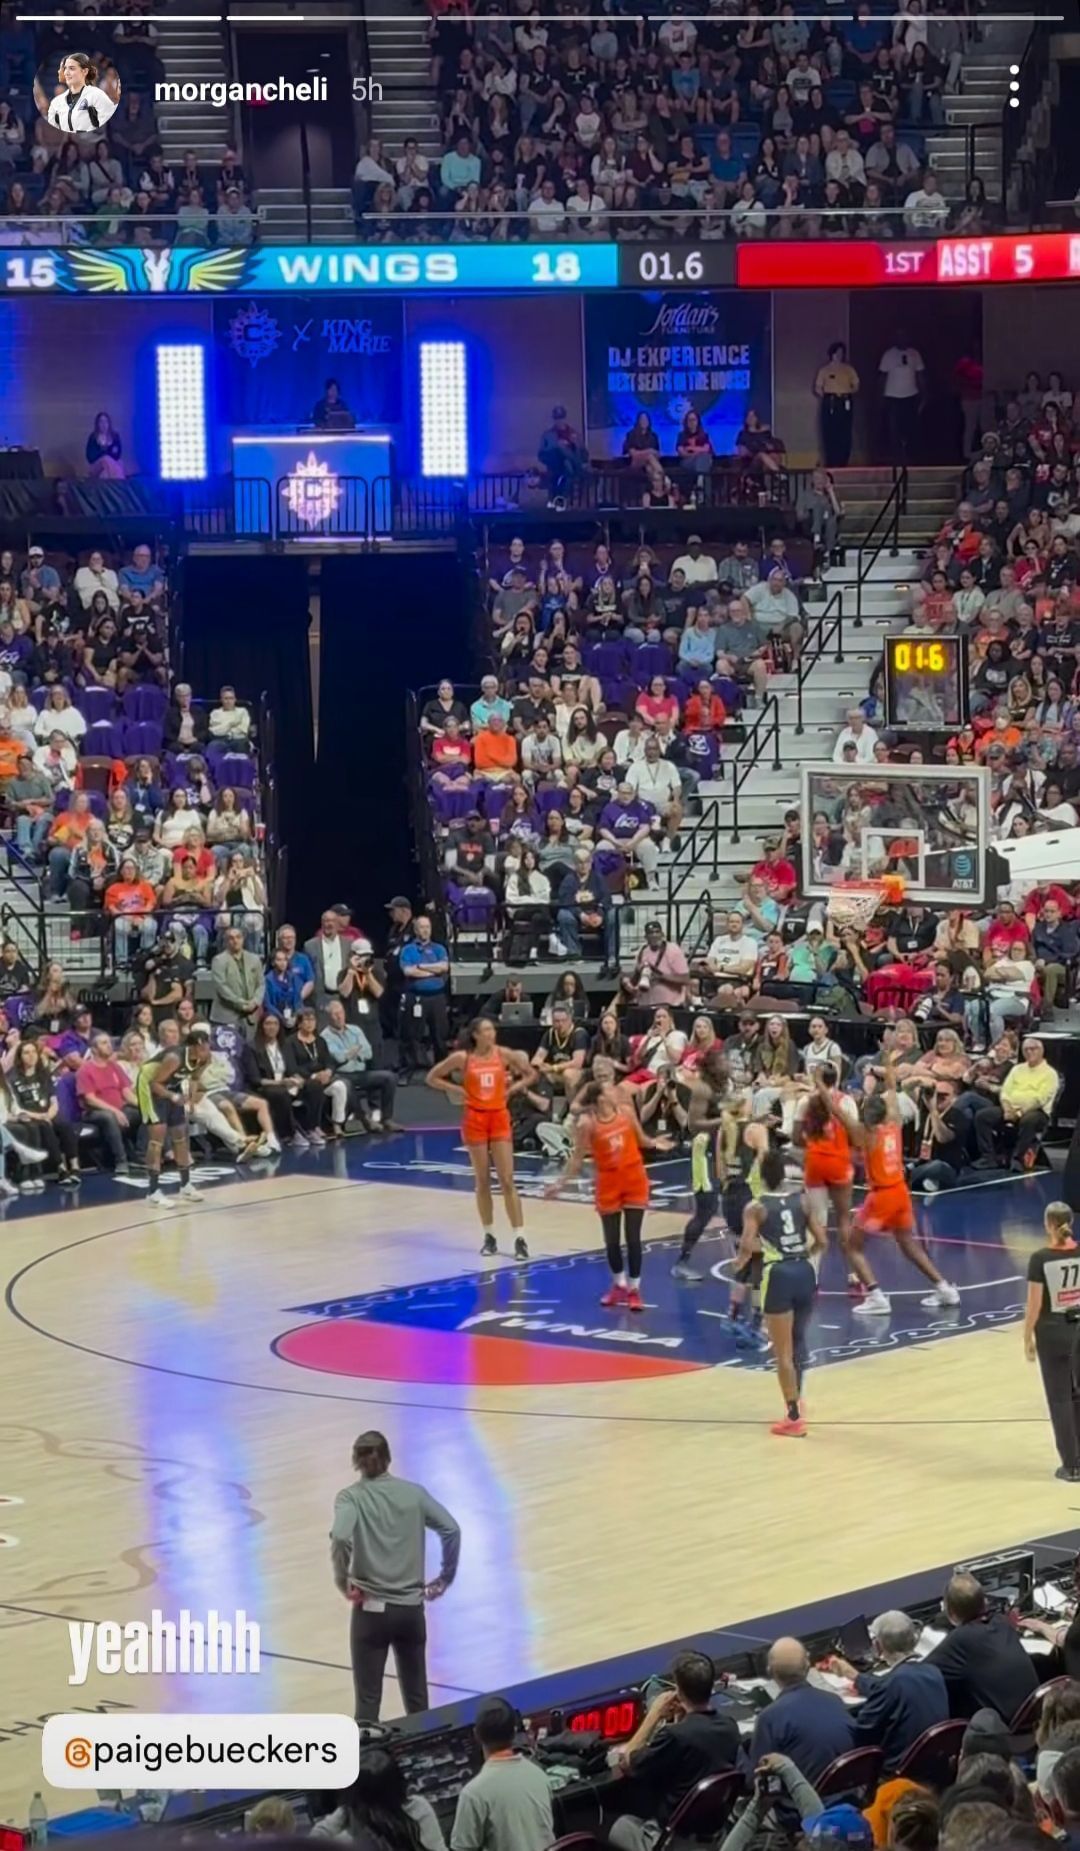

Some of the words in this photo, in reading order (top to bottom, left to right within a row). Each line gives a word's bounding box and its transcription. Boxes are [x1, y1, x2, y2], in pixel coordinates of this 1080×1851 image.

[6, 258, 57, 288] 15
[278, 253, 458, 284] WINGS
[532, 251, 581, 282] 18
[639, 251, 704, 281] 01.6
[885, 252, 924, 273] 1ST
[939, 242, 994, 277] ASST
[1015, 244, 1034, 274] 5
[320, 319, 373, 337] KING
[639, 303, 719, 336] Jordan's
[327, 335, 393, 356] MARIE
[608, 347, 632, 367] DJ
[637, 344, 750, 367] EXPERIENCE
[952, 879, 974, 889] AT&T
[780, 1209, 795, 1234] 3
[1061, 1264, 1079, 1288] 77
